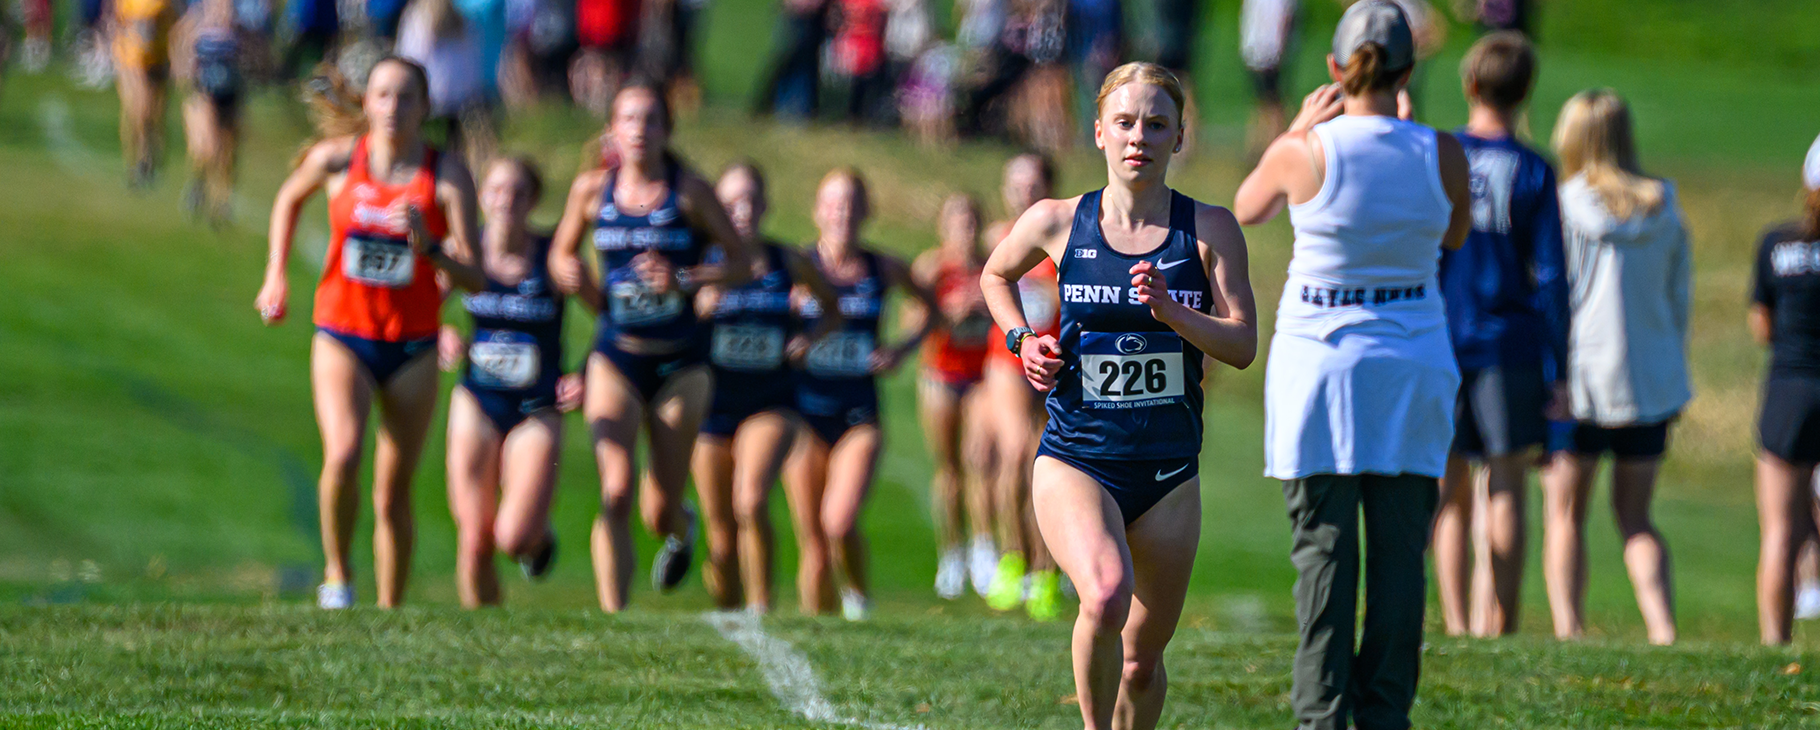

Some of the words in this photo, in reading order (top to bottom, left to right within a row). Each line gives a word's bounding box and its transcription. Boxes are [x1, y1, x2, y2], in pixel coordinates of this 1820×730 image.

[1064, 284, 1121, 304] PENN
[1128, 287, 1203, 309] SATE
[1099, 358, 1166, 396] 226
[1134, 397, 1175, 408] INVITATIONAL
